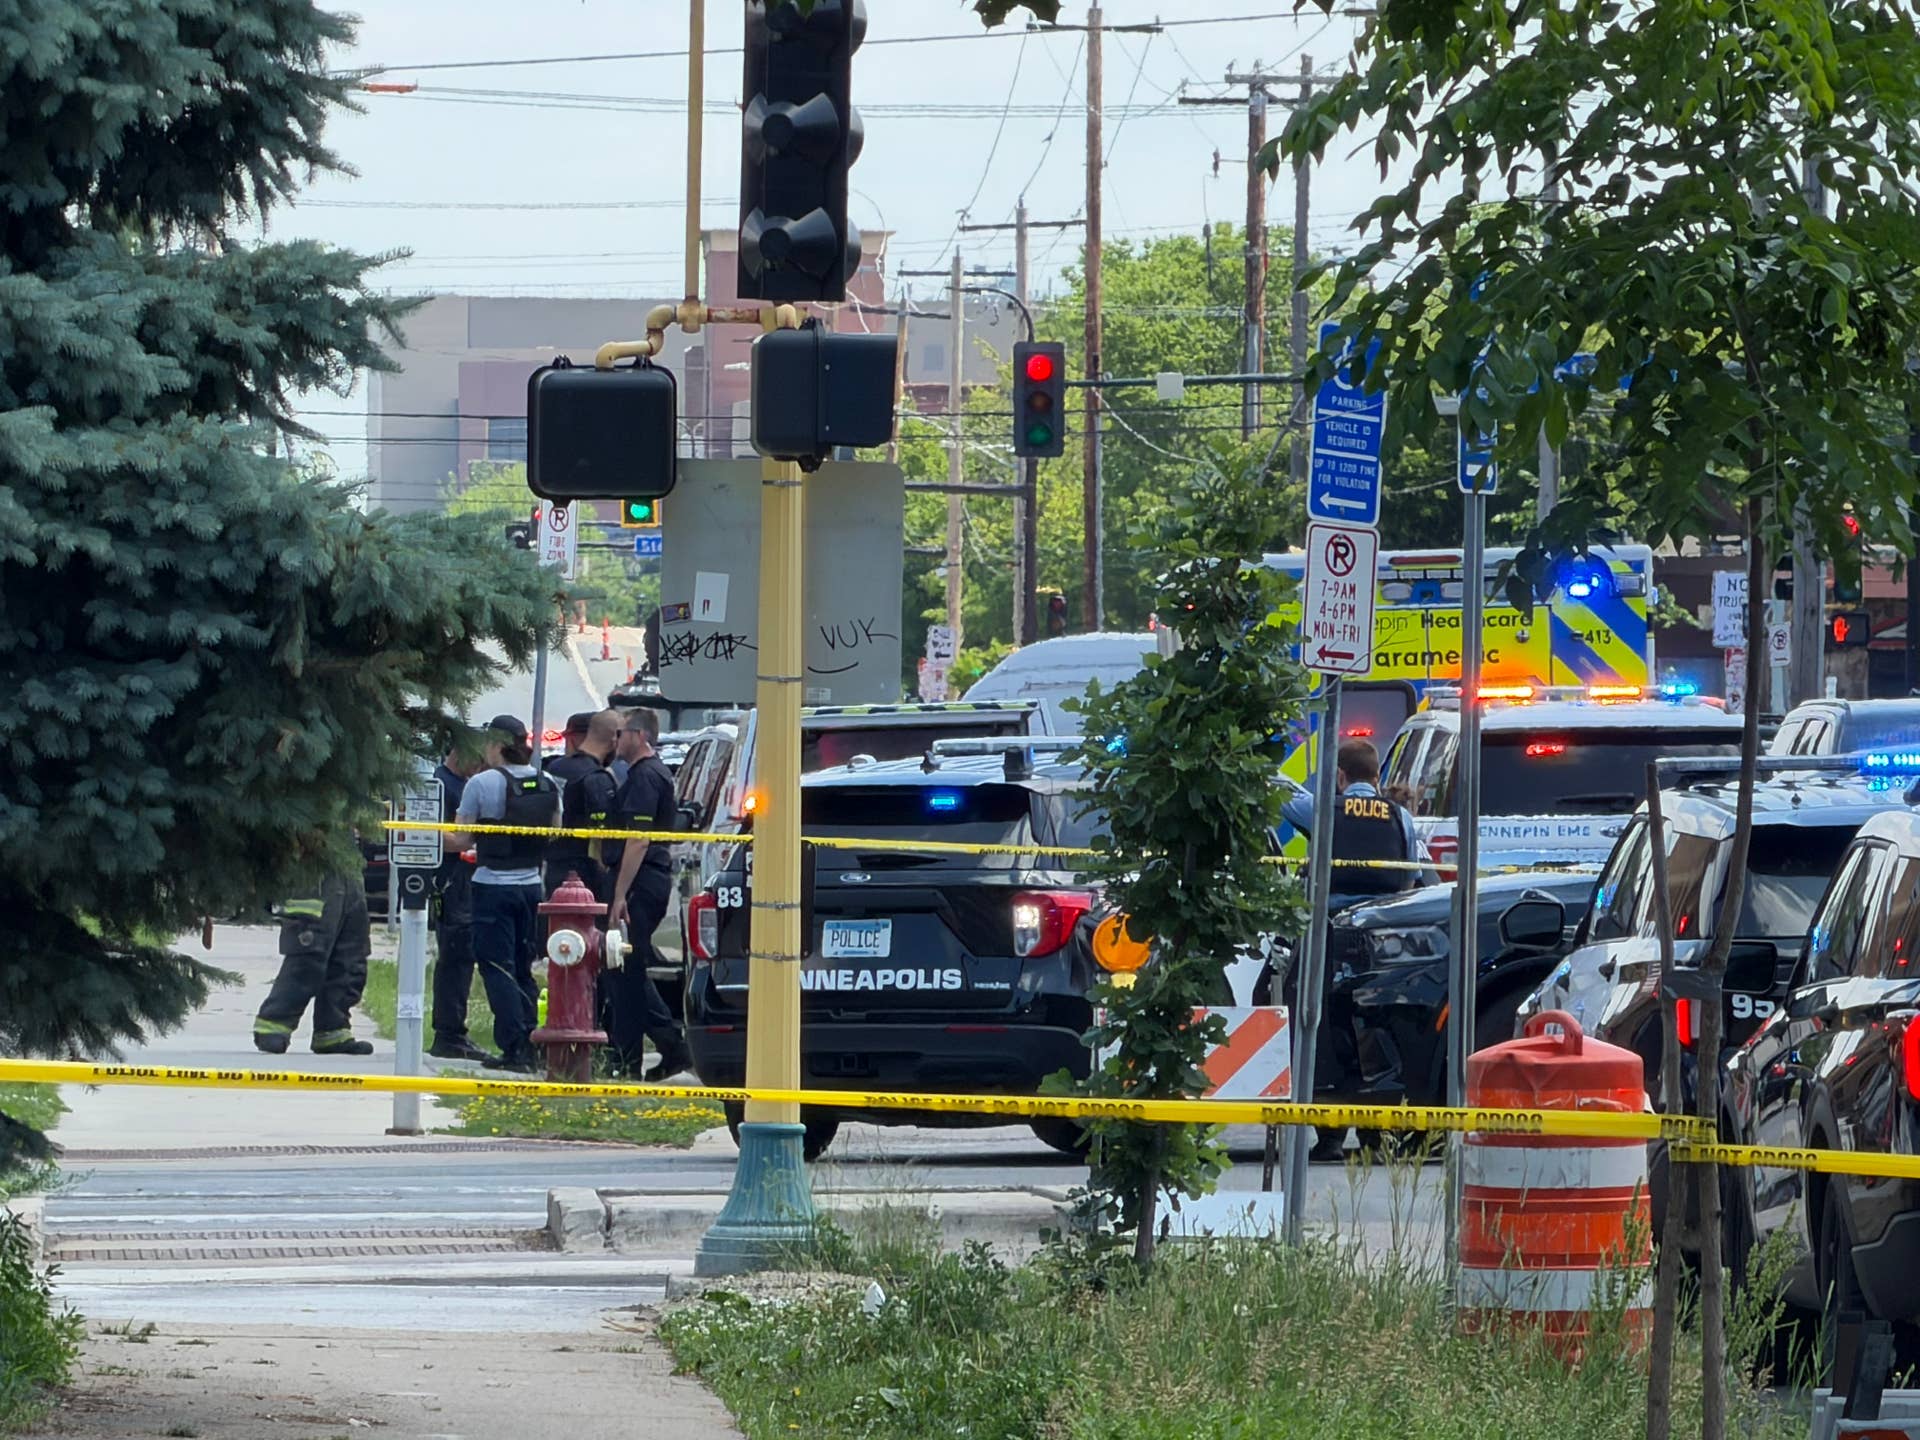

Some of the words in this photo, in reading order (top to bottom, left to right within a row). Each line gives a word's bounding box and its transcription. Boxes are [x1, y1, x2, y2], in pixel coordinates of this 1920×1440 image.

[1325, 420, 1358, 434] VEHICLE
[1362, 425, 1371, 436] ID
[1327, 434, 1367, 451] REQUIRED
[1314, 458, 1324, 468] UP
[1328, 460, 1336, 470] TO
[1360, 464, 1376, 477] FINE
[1318, 473, 1331, 485] FOR
[1335, 476, 1370, 491] VIOLATION
[1321, 579, 1356, 600] 7-9AM
[1320, 601, 1355, 620] 4-6PM
[1313, 620, 1360, 643] MON-FRI
[1585, 629, 1611, 645] 413
[1345, 797, 1390, 819] POLICE
[1479, 825, 1549, 838] ENNEPIN
[1557, 825, 1590, 837] EMS
[717, 887, 743, 908] 83
[831, 930, 880, 949] POLICE
[799, 969, 962, 990] NNEAPOLIS
[1732, 994, 1775, 1018] 95
